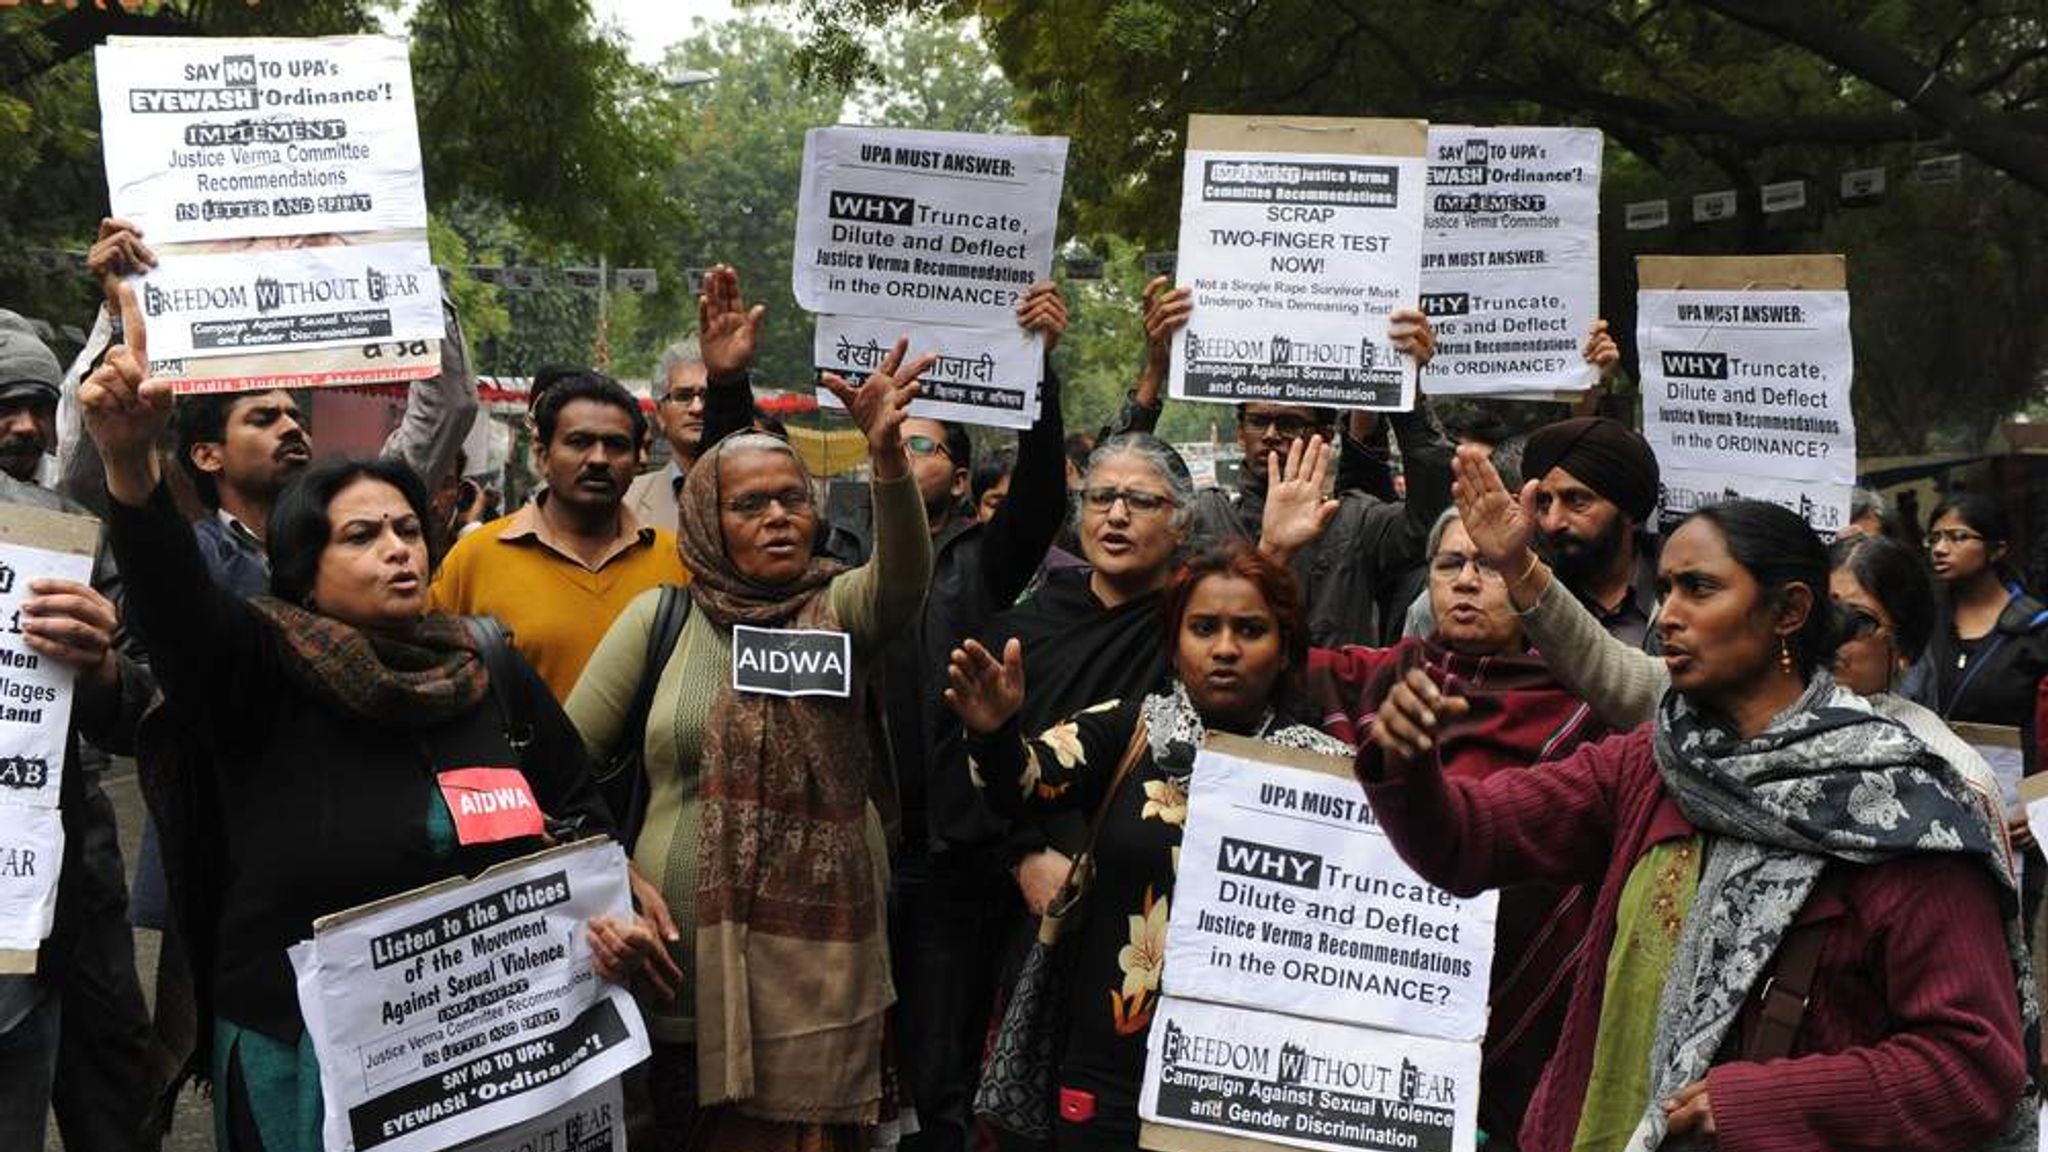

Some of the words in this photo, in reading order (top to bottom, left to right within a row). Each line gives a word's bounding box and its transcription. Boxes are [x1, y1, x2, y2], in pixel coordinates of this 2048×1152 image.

[185, 62, 218, 81] SAY
[225, 59, 253, 82] NO
[259, 60, 282, 78] TO
[289, 60, 338, 77] UPA's
[131, 91, 256, 112] EYEWASH
[186, 121, 345, 145] IMPLEMENT
[168, 152, 225, 168] Justice
[231, 149, 281, 164] Verma
[287, 143, 369, 162] Committee
[861, 145, 891, 163] UPA
[895, 149, 944, 169] MUST
[944, 154, 1015, 177] ANSWER:
[1440, 146, 1463, 161] SAY
[1467, 145, 1486, 160] NO
[1490, 146, 1506, 159] TO
[1511, 146, 1546, 159] UPA's
[198, 168, 347, 192] Recommendations
[1211, 164, 1300, 182] IMPLEMENT
[1301, 169, 1345, 182] Justice
[1350, 172, 1389, 184] Verma
[1205, 187, 1271, 199] Committee
[1435, 194, 1546, 212] IMPLEMENT
[177, 203, 198, 220] IN
[203, 201, 269, 218] LETTER
[274, 198, 313, 215] AND
[318, 195, 372, 212] SPIRIT
[834, 197, 909, 221] WHY
[918, 205, 1028, 235] Truncate,
[1267, 207, 1335, 222] SCRAP
[1465, 215, 1496, 228] Verma
[1501, 214, 1559, 228] Committee
[832, 225, 894, 247] Dilute
[903, 235, 943, 252] and
[951, 237, 1026, 259] Deflect
[1210, 230, 1334, 249] TWO-FINGER
[1341, 235, 1390, 252] TEST
[817, 249, 863, 268] Justice
[868, 254, 909, 273] Verma
[914, 258, 1035, 284] Recommendations
[1270, 257, 1324, 273] NOW!
[1448, 253, 1484, 266] MUST
[829, 276, 845, 292] in
[852, 279, 881, 294] the
[887, 280, 1018, 306] ORDINANCE?
[1195, 279, 1217, 290] Not
[1220, 282, 1227, 290] a
[1232, 281, 1270, 294] Single
[1275, 282, 1306, 295] Rape
[1311, 284, 1363, 297] Survivor
[1368, 286, 1399, 297] Must
[1199, 297, 1252, 309] Undergo
[1257, 298, 1282, 309] This
[1287, 300, 1359, 315] Demeaning
[1422, 297, 1463, 313] HY
[1473, 296, 1566, 311] Truncate,
[1678, 305, 1700, 321] UPA
[1705, 305, 1739, 322] MUST
[1743, 306, 1805, 323] ANSWER:
[194, 322, 247, 336] Campaign
[252, 318, 294, 330] Against
[301, 314, 338, 326] Sexual
[344, 311, 389, 323] Violence
[217, 335, 239, 345] and
[243, 331, 285, 344] Gender
[291, 326, 369, 341] Discrimination
[1463, 323, 1496, 333] and
[1504, 318, 1567, 332] Deflect
[1438, 342, 1471, 355] Verma
[1475, 339, 1576, 353] Recommendations
[1186, 365, 1247, 376] Campaign
[1250, 365, 1298, 380] Against
[1303, 367, 1344, 380] Sexual
[1350, 371, 1401, 384] Violence
[1426, 362, 1449, 375] the
[1454, 359, 1565, 374] ORDINANCE?
[1664, 357, 1720, 375] WHY
[1730, 359, 1826, 380] Truncate,
[1208, 382, 1231, 393] and
[1236, 383, 1281, 395] Gender
[1286, 385, 1376, 400] Discrimination
[1667, 383, 1715, 401] Dilute
[1723, 388, 1755, 403] and
[1762, 388, 1828, 408] Deflect
[1659, 408, 1695, 424] Justice
[1698, 410, 1732, 426] Verma
[1736, 411, 1839, 434] Recommendations
[1672, 432, 1685, 445] in
[1689, 434, 1712, 448] the
[1717, 435, 1829, 458] ORDINANCE?
[738, 647, 842, 675] AIDWA
[460, 788, 531, 816] AIDWA
[1260, 783, 1296, 809] UPA
[1302, 792, 1353, 821] MUST
[1226, 846, 1313, 881] WHY
[1326, 865, 1461, 912] Truncate,
[374, 929, 436, 965] Listen
[441, 918, 461, 937] to
[466, 905, 499, 929] the
[503, 881, 566, 912] Voices
[1218, 881, 1295, 915] Dilute
[1305, 902, 1354, 925] and
[1366, 908, 1460, 944] Deflect
[404, 962, 424, 984] of
[432, 951, 462, 974] the
[471, 918, 548, 957] Movement
[1197, 910, 1255, 940] Justice
[1261, 922, 1312, 950] Verma
[1318, 933, 1472, 978] Recommendations
[1210, 947, 1232, 967] in
[1239, 952, 1275, 976] the
[1283, 961, 1451, 1006] ORDINANCE?
[382, 984, 441, 1025] Against
[448, 968, 496, 998] Sexual
[408, 1027, 444, 1050] Verma
[448, 1011, 504, 1038] Committee
[442, 1068, 469, 1090] SAY
[471, 1058, 491, 1078] NO
[496, 1050, 513, 1071] TO
[515, 1041, 555, 1065] UPA's
[1163, 1018, 1270, 1073] FREEDOM
[1278, 1041, 1391, 1093] WITHOUT
[1400, 1057, 1456, 1102] FEAR
[1161, 1065, 1245, 1096] Campaign
[1249, 1081, 1313, 1106] Against
[1319, 1093, 1375, 1115] Sexual
[1382, 1104, 1454, 1127] Violence
[382, 1092, 468, 1138] EYEWASH
[1190, 1099, 1222, 1118] and
[1228, 1104, 1290, 1129] Gender
[1296, 1114, 1418, 1148] Discrimination
